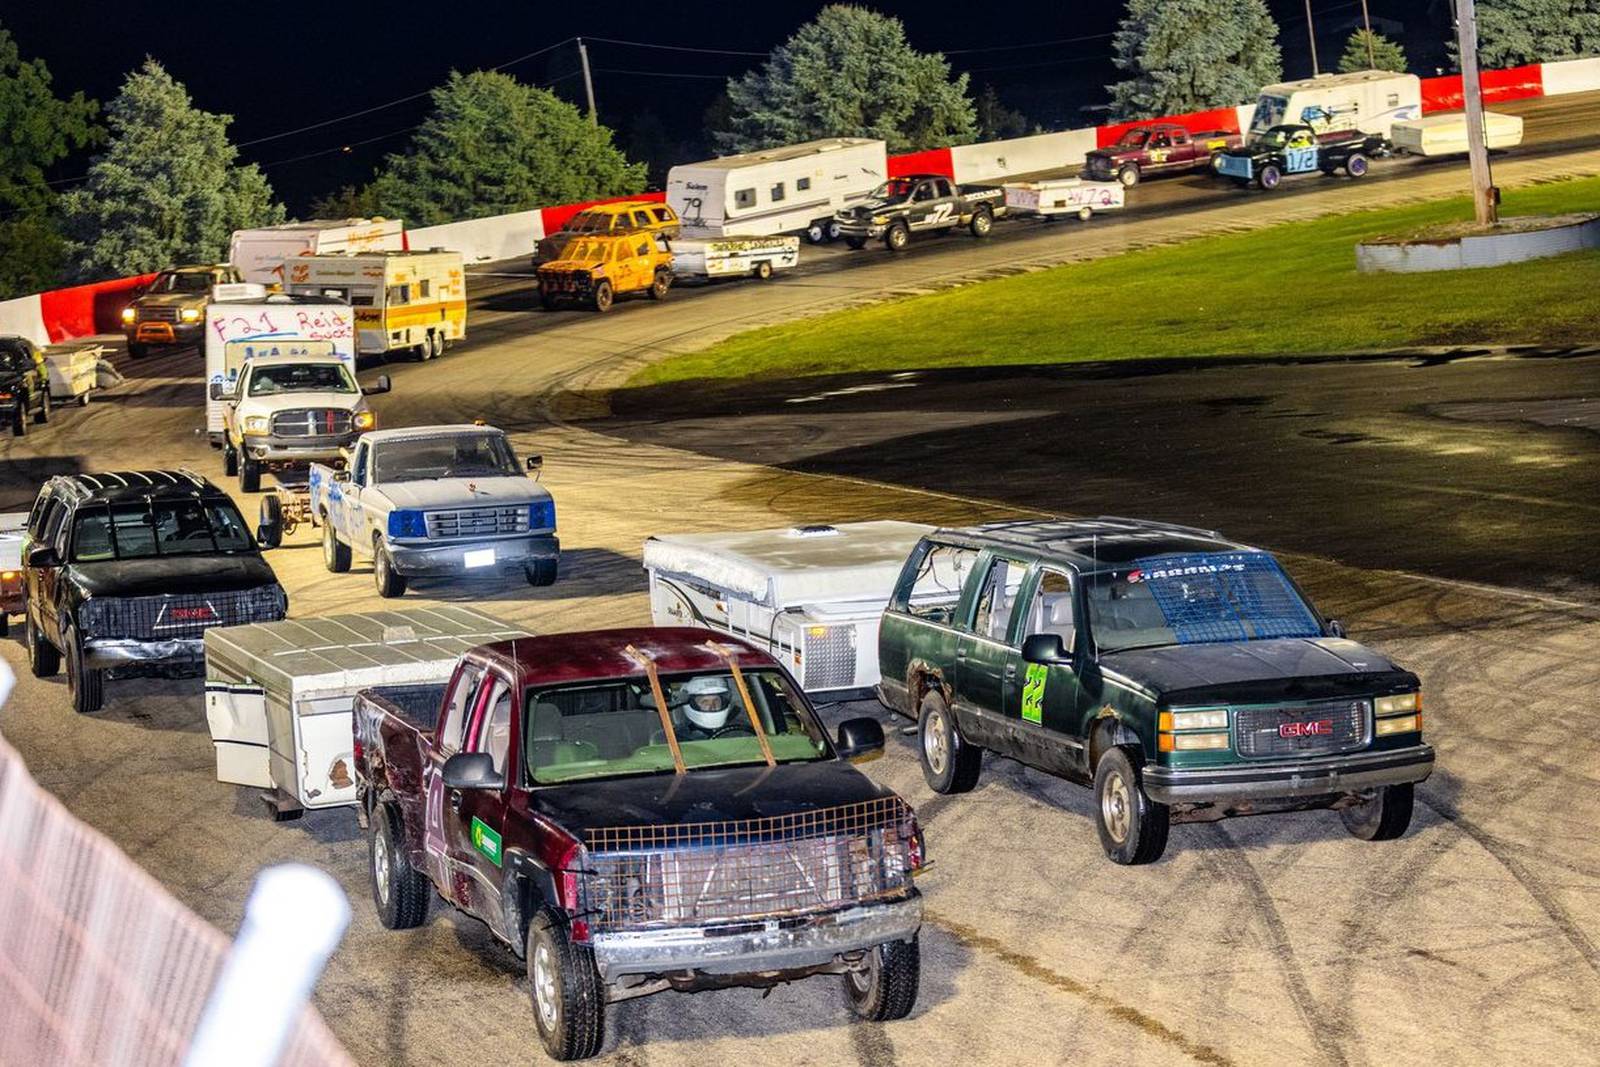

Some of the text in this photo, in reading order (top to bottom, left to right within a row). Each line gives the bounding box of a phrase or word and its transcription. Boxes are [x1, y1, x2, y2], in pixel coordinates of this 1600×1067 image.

[683, 198, 702, 220] 79
[296, 311, 346, 331] Reid
[1280, 720, 1333, 738] GMC
